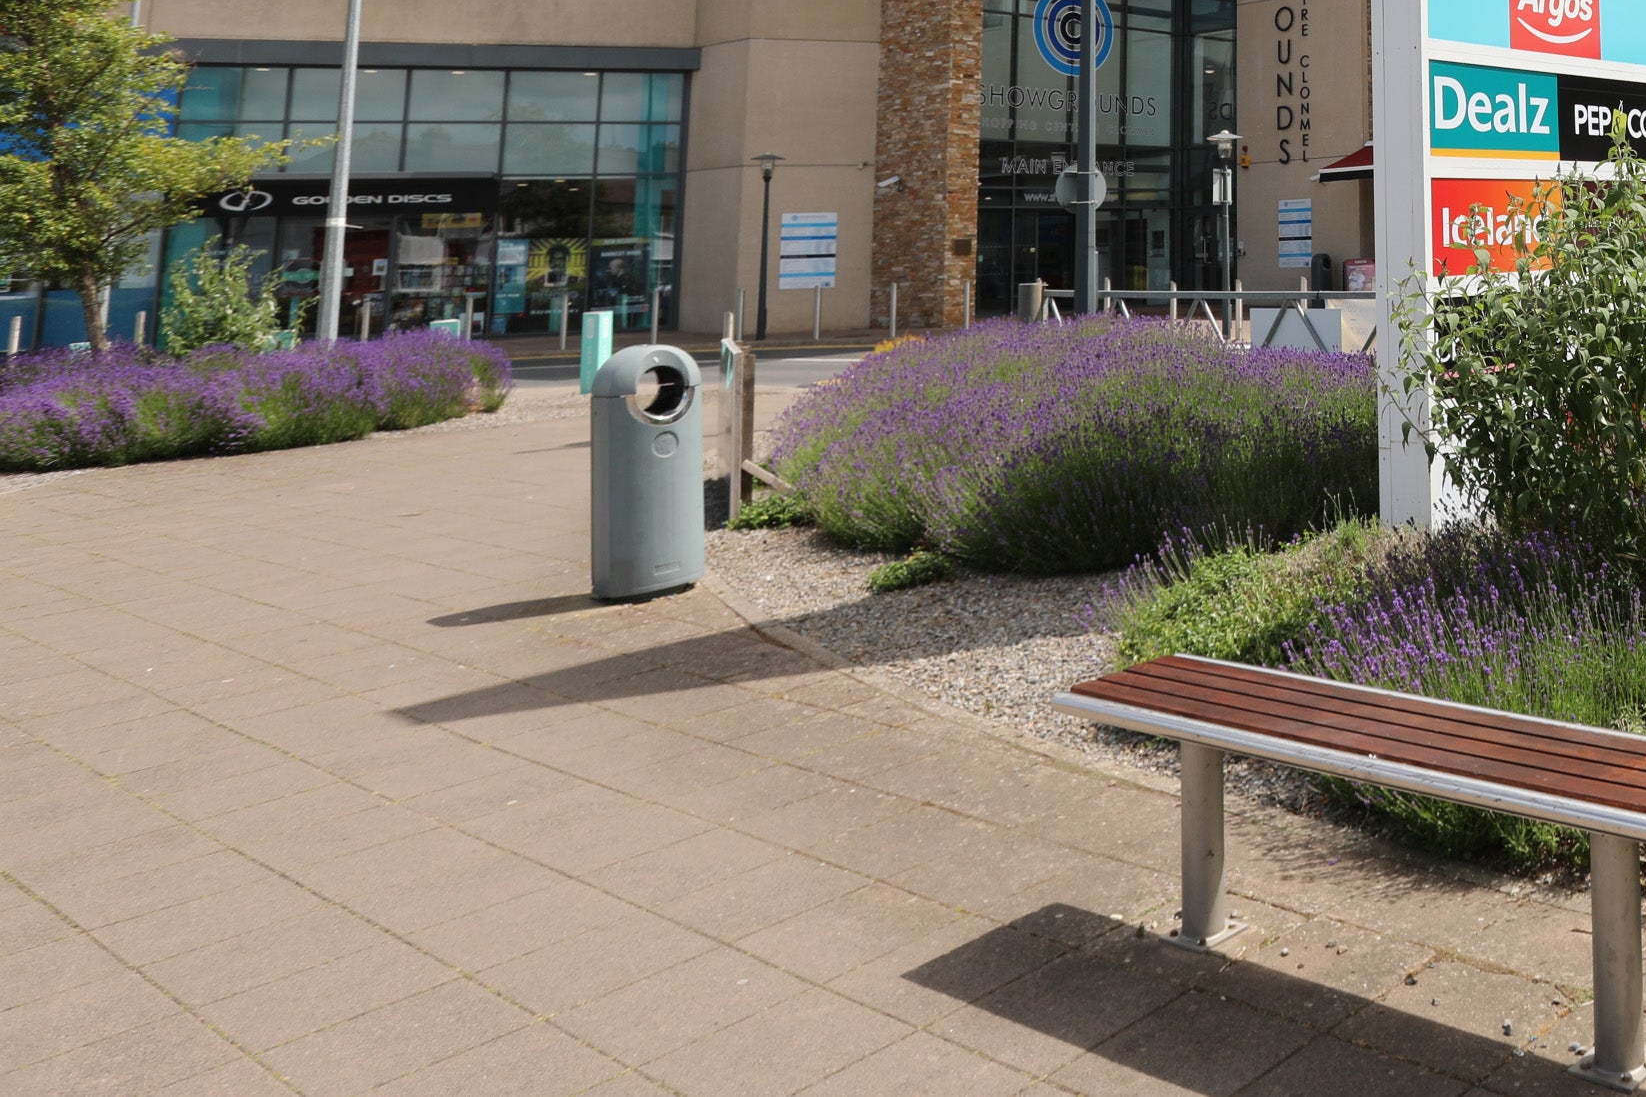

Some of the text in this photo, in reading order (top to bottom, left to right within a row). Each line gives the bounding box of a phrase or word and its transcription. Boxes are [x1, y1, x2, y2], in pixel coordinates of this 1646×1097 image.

[980, 84, 1157, 117] SHOWGRUNDS
[1299, 55, 1311, 163] CLONMEL
[1433, 75, 1550, 135] Dealz
[1001, 157, 1047, 174] MAIN
[292, 193, 452, 205] GOEN DISCS
